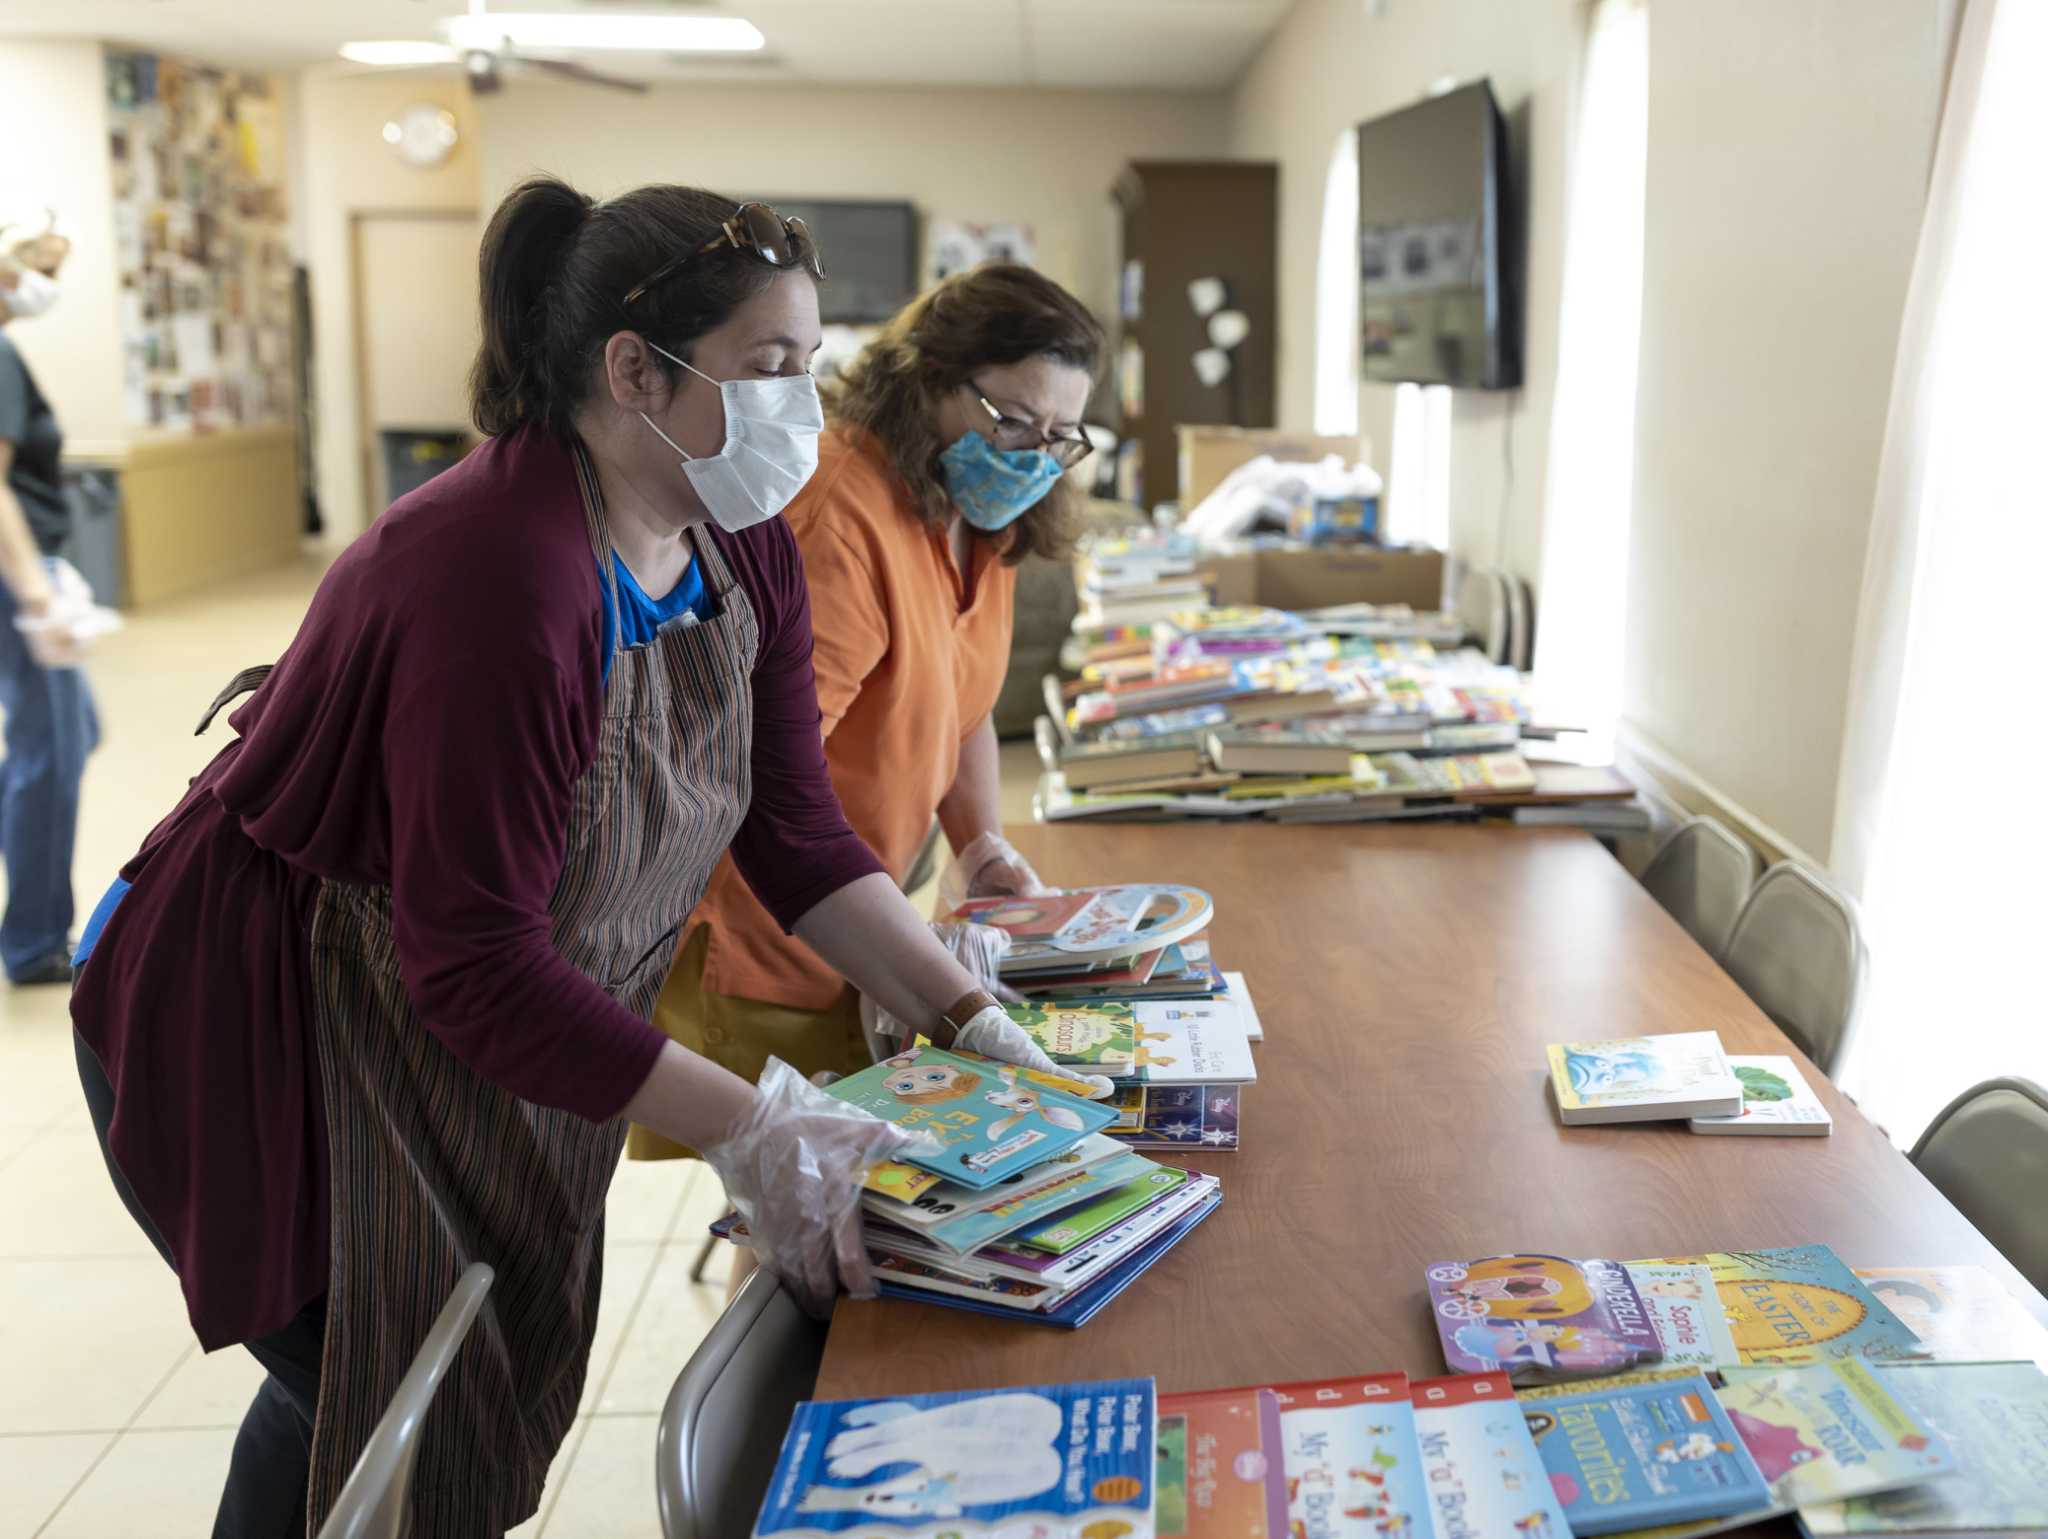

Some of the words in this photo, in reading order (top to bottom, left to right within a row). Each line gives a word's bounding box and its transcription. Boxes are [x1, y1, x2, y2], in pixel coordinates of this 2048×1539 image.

[1597, 1269, 1651, 1336] CINDERELLA
[1668, 1304, 1701, 1345] Sophie
[1740, 1283, 1812, 1343] EASTER
[1556, 1401, 1632, 1505] favorites
